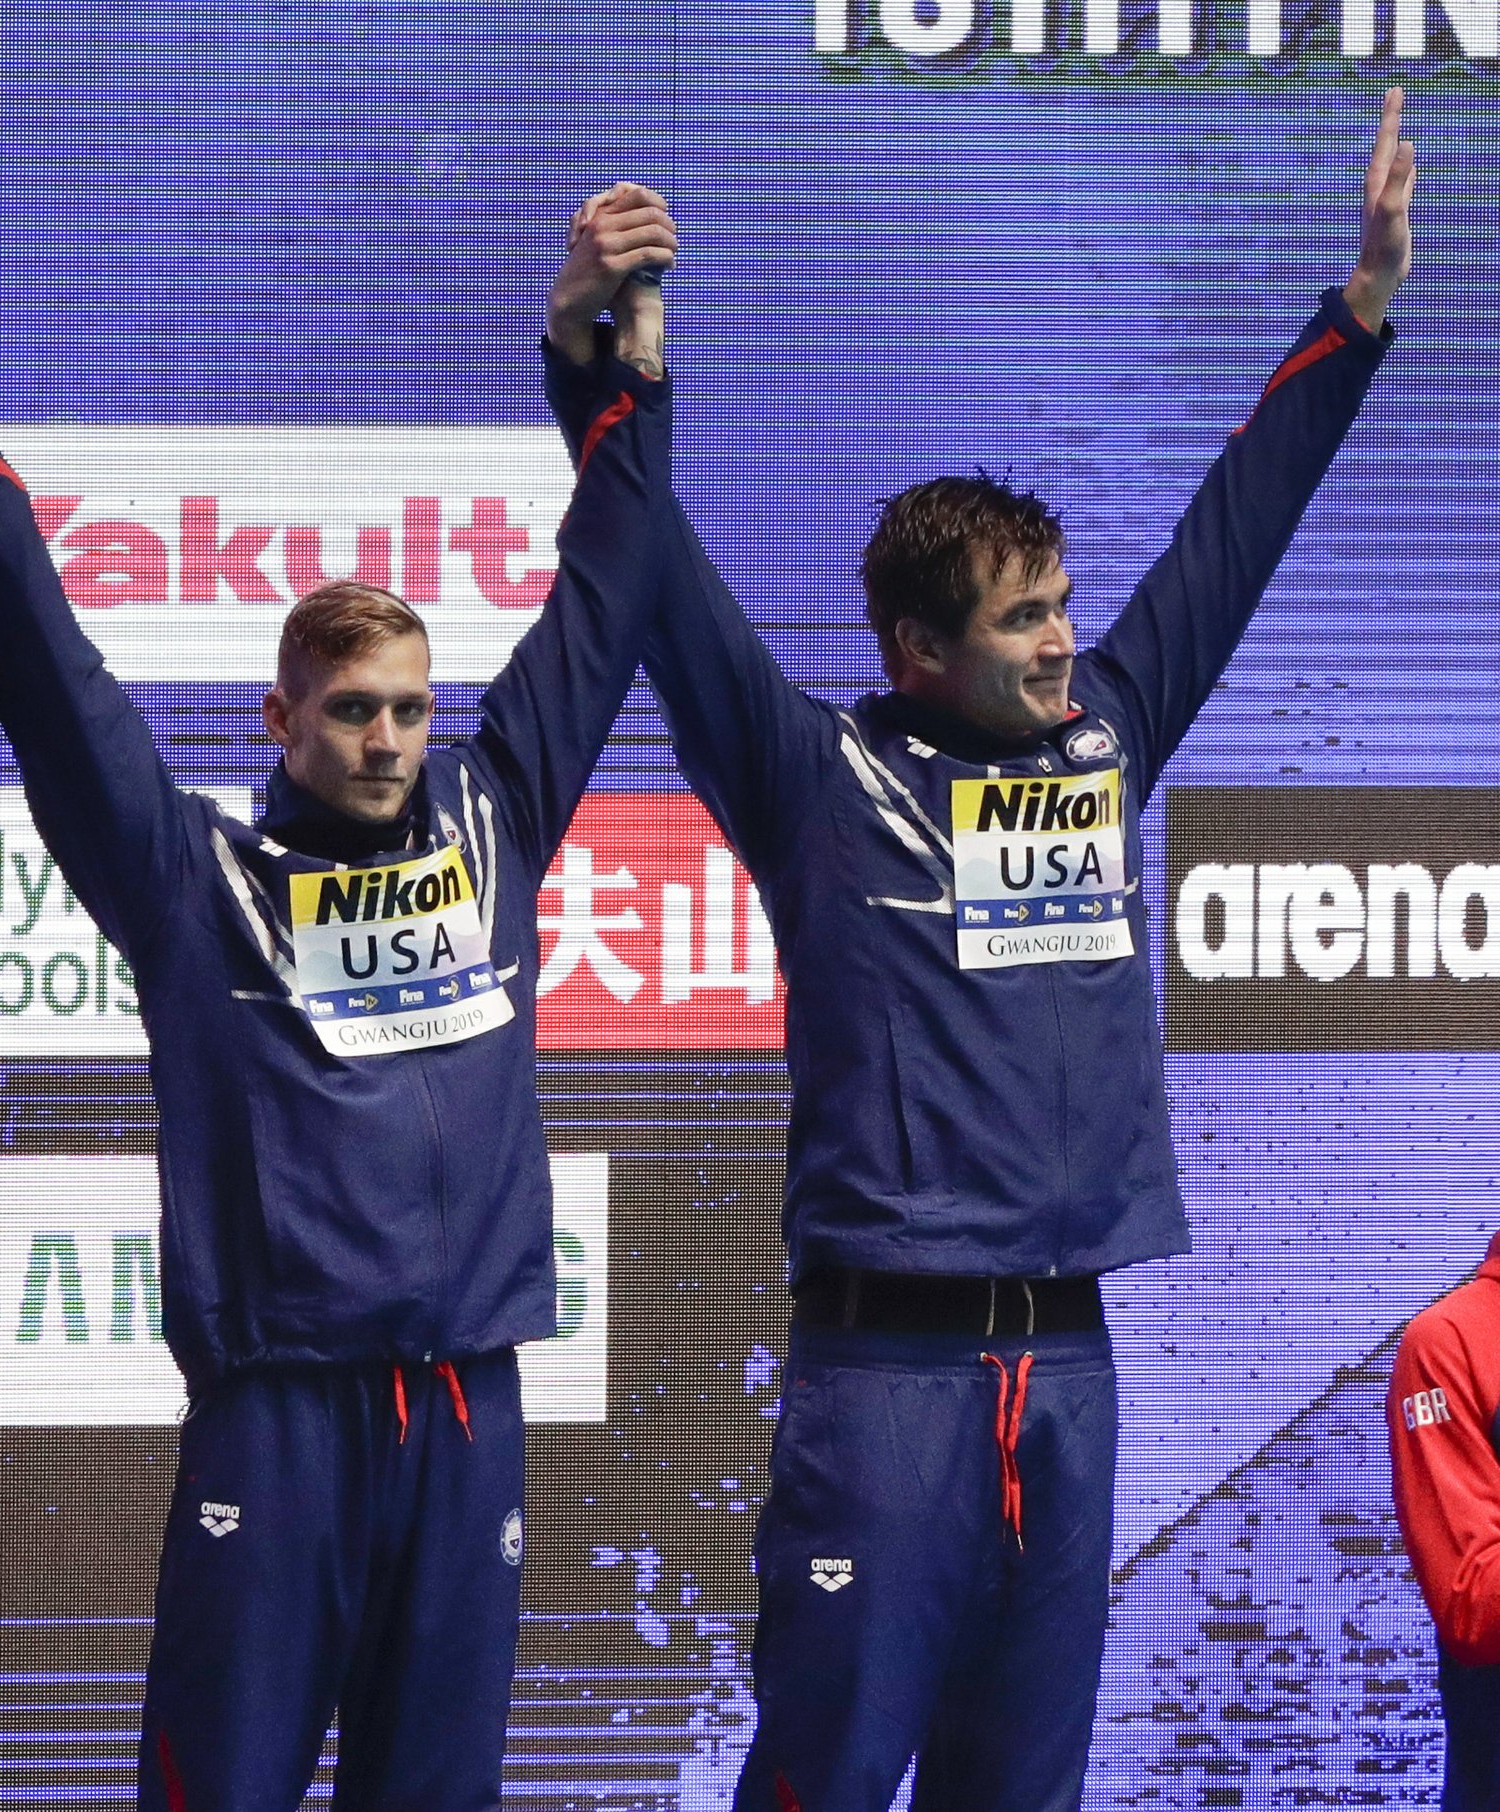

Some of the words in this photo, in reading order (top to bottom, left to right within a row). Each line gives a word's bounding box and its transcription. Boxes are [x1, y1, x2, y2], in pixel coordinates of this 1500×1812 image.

[977, 782, 1110, 832] Nikon
[1000, 842, 1103, 891] USA
[316, 865, 461, 926] Nikon
[1084, 933, 1116, 951] 2019
[1176, 862, 1500, 981] arena
[341, 923, 456, 980] USA
[452, 1009, 484, 1033] 2019
[1403, 1388, 1451, 1431] GBR
[201, 1501, 240, 1520] arena
[811, 1558, 852, 1572] arena
